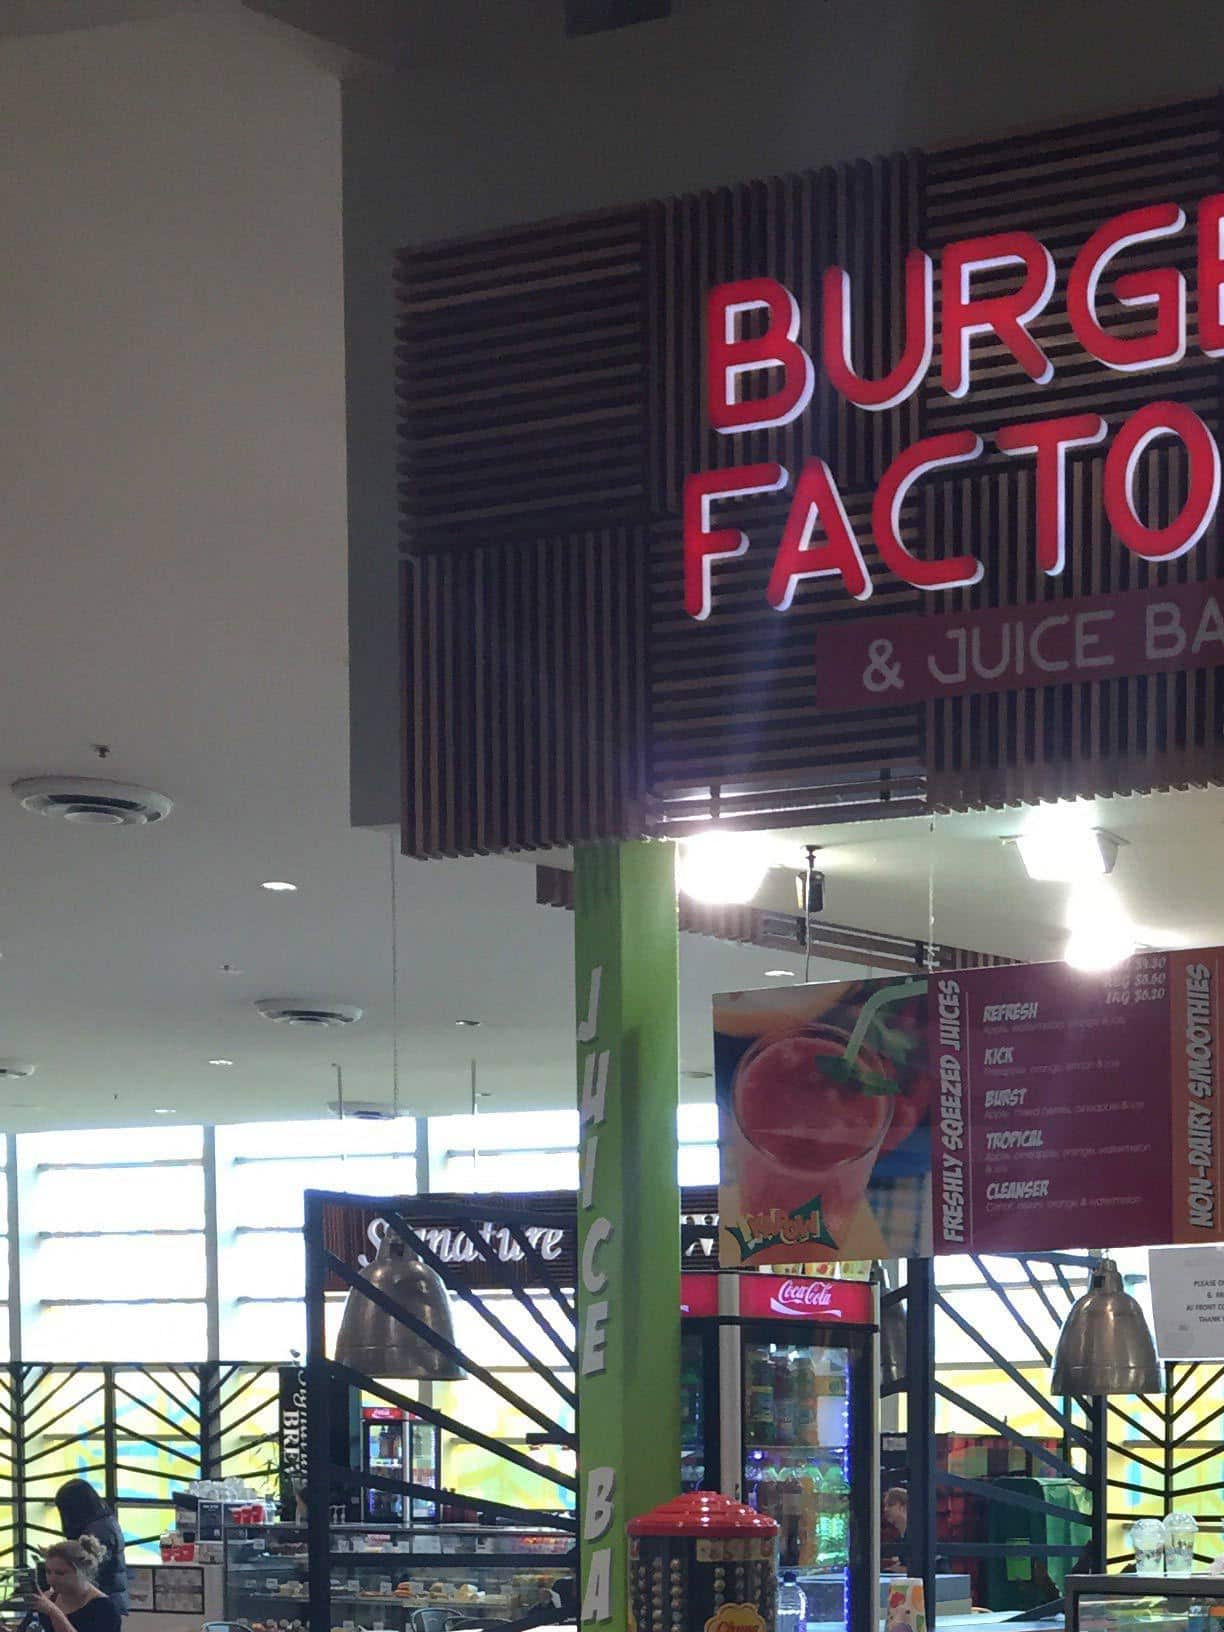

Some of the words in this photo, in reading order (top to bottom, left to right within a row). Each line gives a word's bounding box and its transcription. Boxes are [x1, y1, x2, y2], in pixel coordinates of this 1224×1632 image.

[862, 638, 905, 692] &
[928, 609, 1116, 686] JUICE
[937, 979, 962, 1052] JUICES
[983, 1002, 1038, 1022] REFRESH
[1185, 963, 1212, 1098] SMOOTHIES
[984, 1047, 1014, 1065] KICK
[984, 1088, 1028, 1107] BURST
[577, 968, 613, 1377] JUICE
[986, 1129, 1044, 1149] TROPICAL
[1188, 1102, 1214, 1229] NON-DAIRY
[941, 1156, 965, 1243] FRESHLY
[986, 1179, 1050, 1201] CLEANSER
